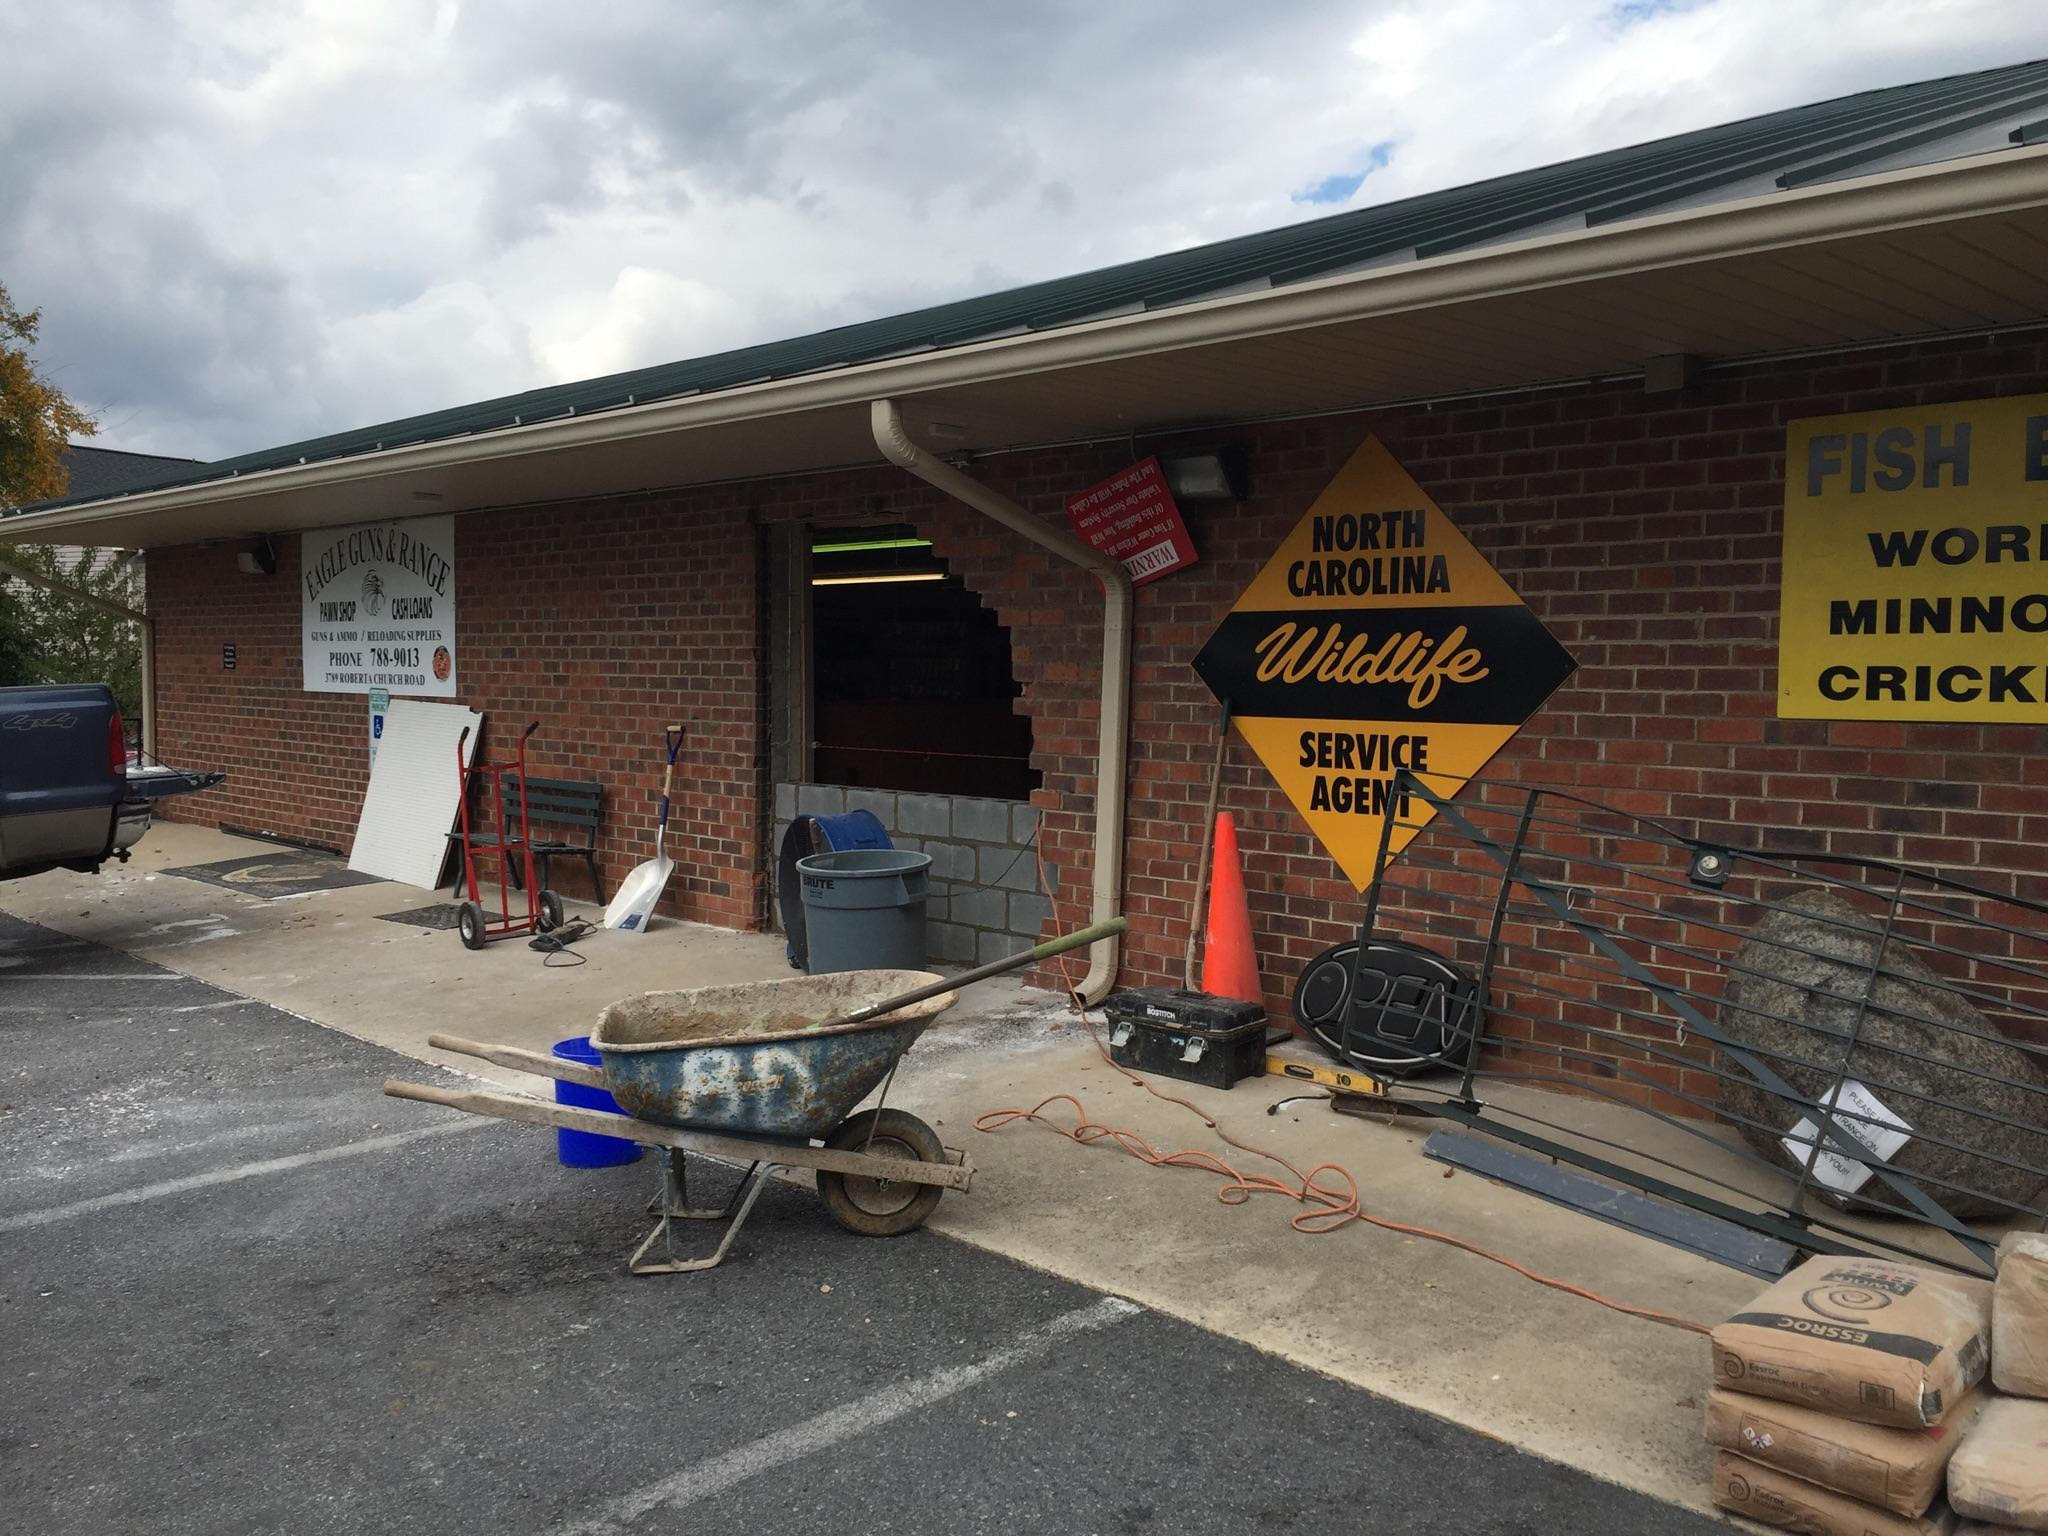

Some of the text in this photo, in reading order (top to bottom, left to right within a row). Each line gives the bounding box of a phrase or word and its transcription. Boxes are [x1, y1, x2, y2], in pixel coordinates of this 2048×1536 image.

[1807, 422, 1972, 497] FISH
[1313, 510, 1426, 553] NORTH
[1868, 523, 2048, 567] WOR
[306, 528, 450, 602] EAGLE GUNS & RANGE
[1126, 546, 1174, 577] WARNIN
[1287, 555, 1451, 597] CAROLINA
[320, 600, 356, 622] PAWN SHOP
[392, 596, 432, 620] CASH LOANS
[311, 631, 327, 641] GUNS
[337, 631, 358, 641] AMMO
[367, 630, 406, 641] RELOADING
[407, 629, 442, 640] SUPPLIES
[329, 647, 420, 668] PHONE 788-9013
[1255, 622, 1489, 709] Wildlife
[340, 672, 373, 684] ROBERTA
[373, 673, 404, 685] CHURCH
[405, 674, 425, 685] ROAD
[1818, 665, 2048, 703] CRICK
[1299, 731, 1429, 772] SERVICE
[803, 875, 835, 890] BRUTE
[1146, 1007, 1175, 1019] BOSTITCH
[1849, 1091, 1876, 1119] PLEASE
[1866, 1141, 1879, 1153] ON
[1778, 1317, 1869, 1343] ESSROC
